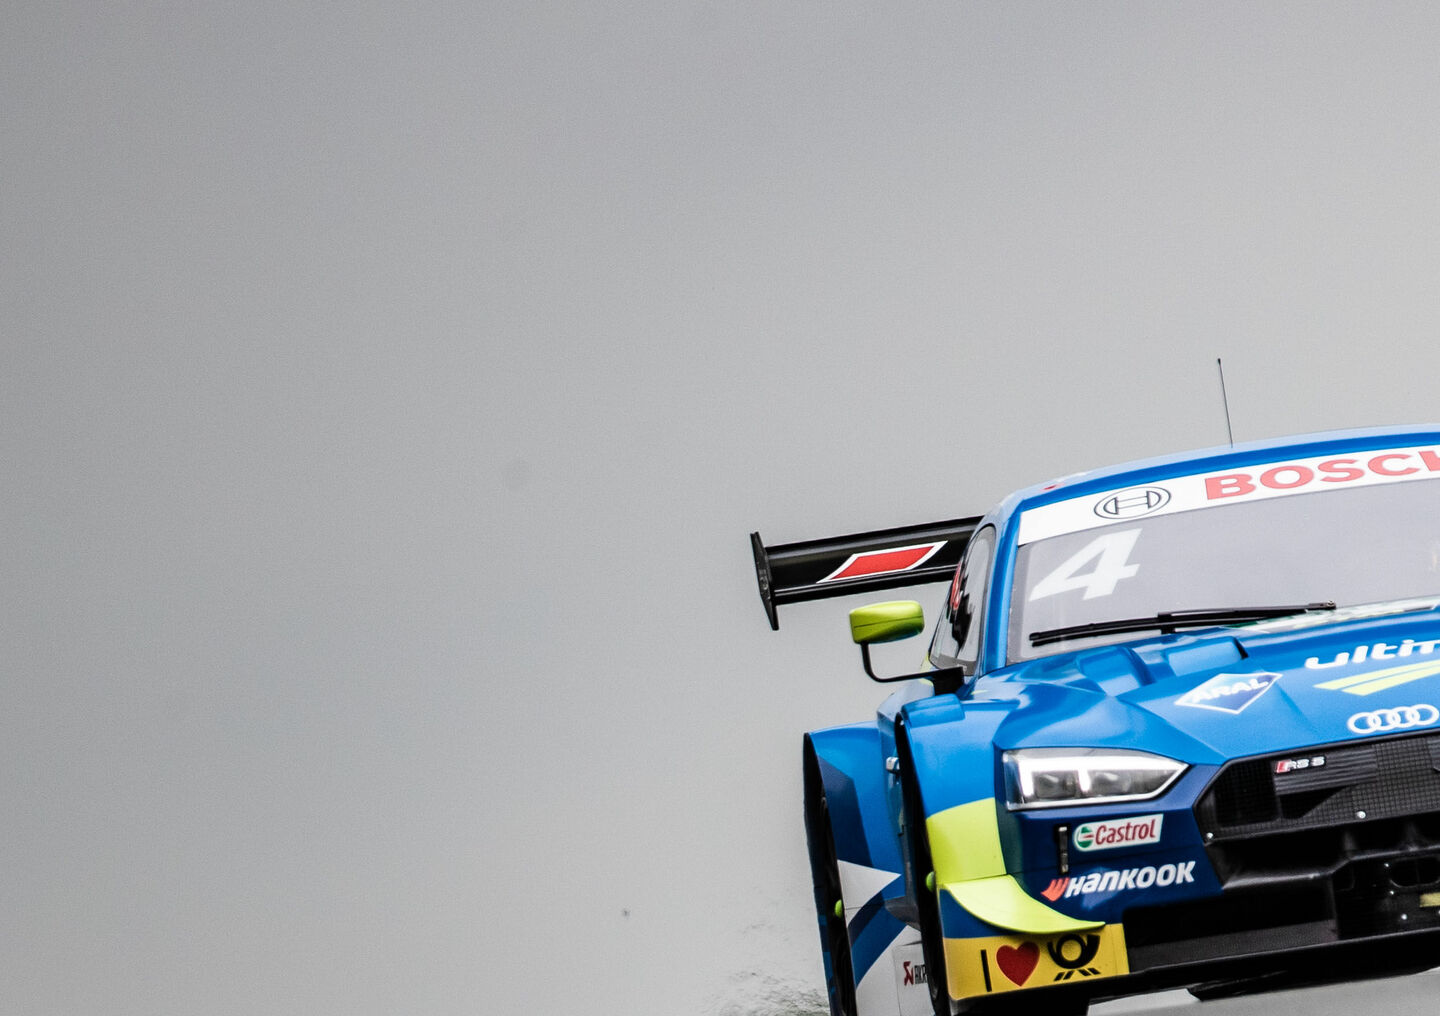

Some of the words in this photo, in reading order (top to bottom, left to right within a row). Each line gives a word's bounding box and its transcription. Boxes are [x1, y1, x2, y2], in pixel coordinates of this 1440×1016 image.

[1028, 528, 1143, 602] 4
[1191, 678, 1269, 704] ARAL
[1095, 819, 1156, 845] Castrol
